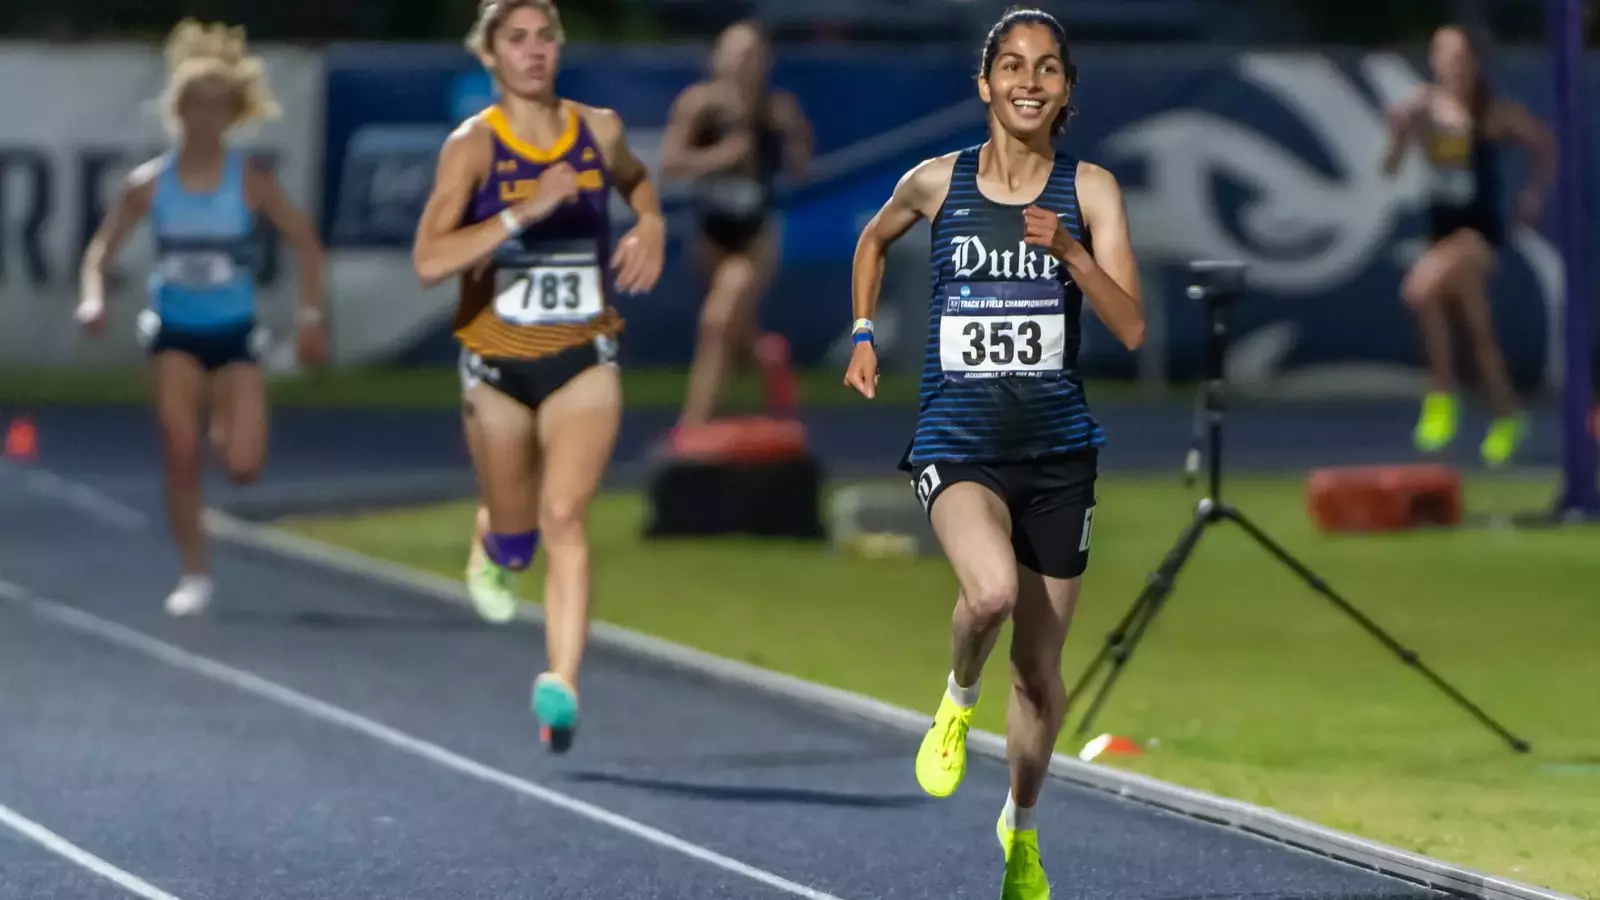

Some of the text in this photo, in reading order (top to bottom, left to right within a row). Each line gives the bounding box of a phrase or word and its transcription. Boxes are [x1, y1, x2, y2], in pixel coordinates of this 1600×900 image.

[950, 235, 1060, 280] Duke
[515, 272, 581, 310] 783
[960, 300, 980, 308] TRACK
[985, 300, 1003, 308] FIELD
[1004, 299, 1059, 308] CHAMPIONSHIPS
[962, 321, 1042, 366] 353
